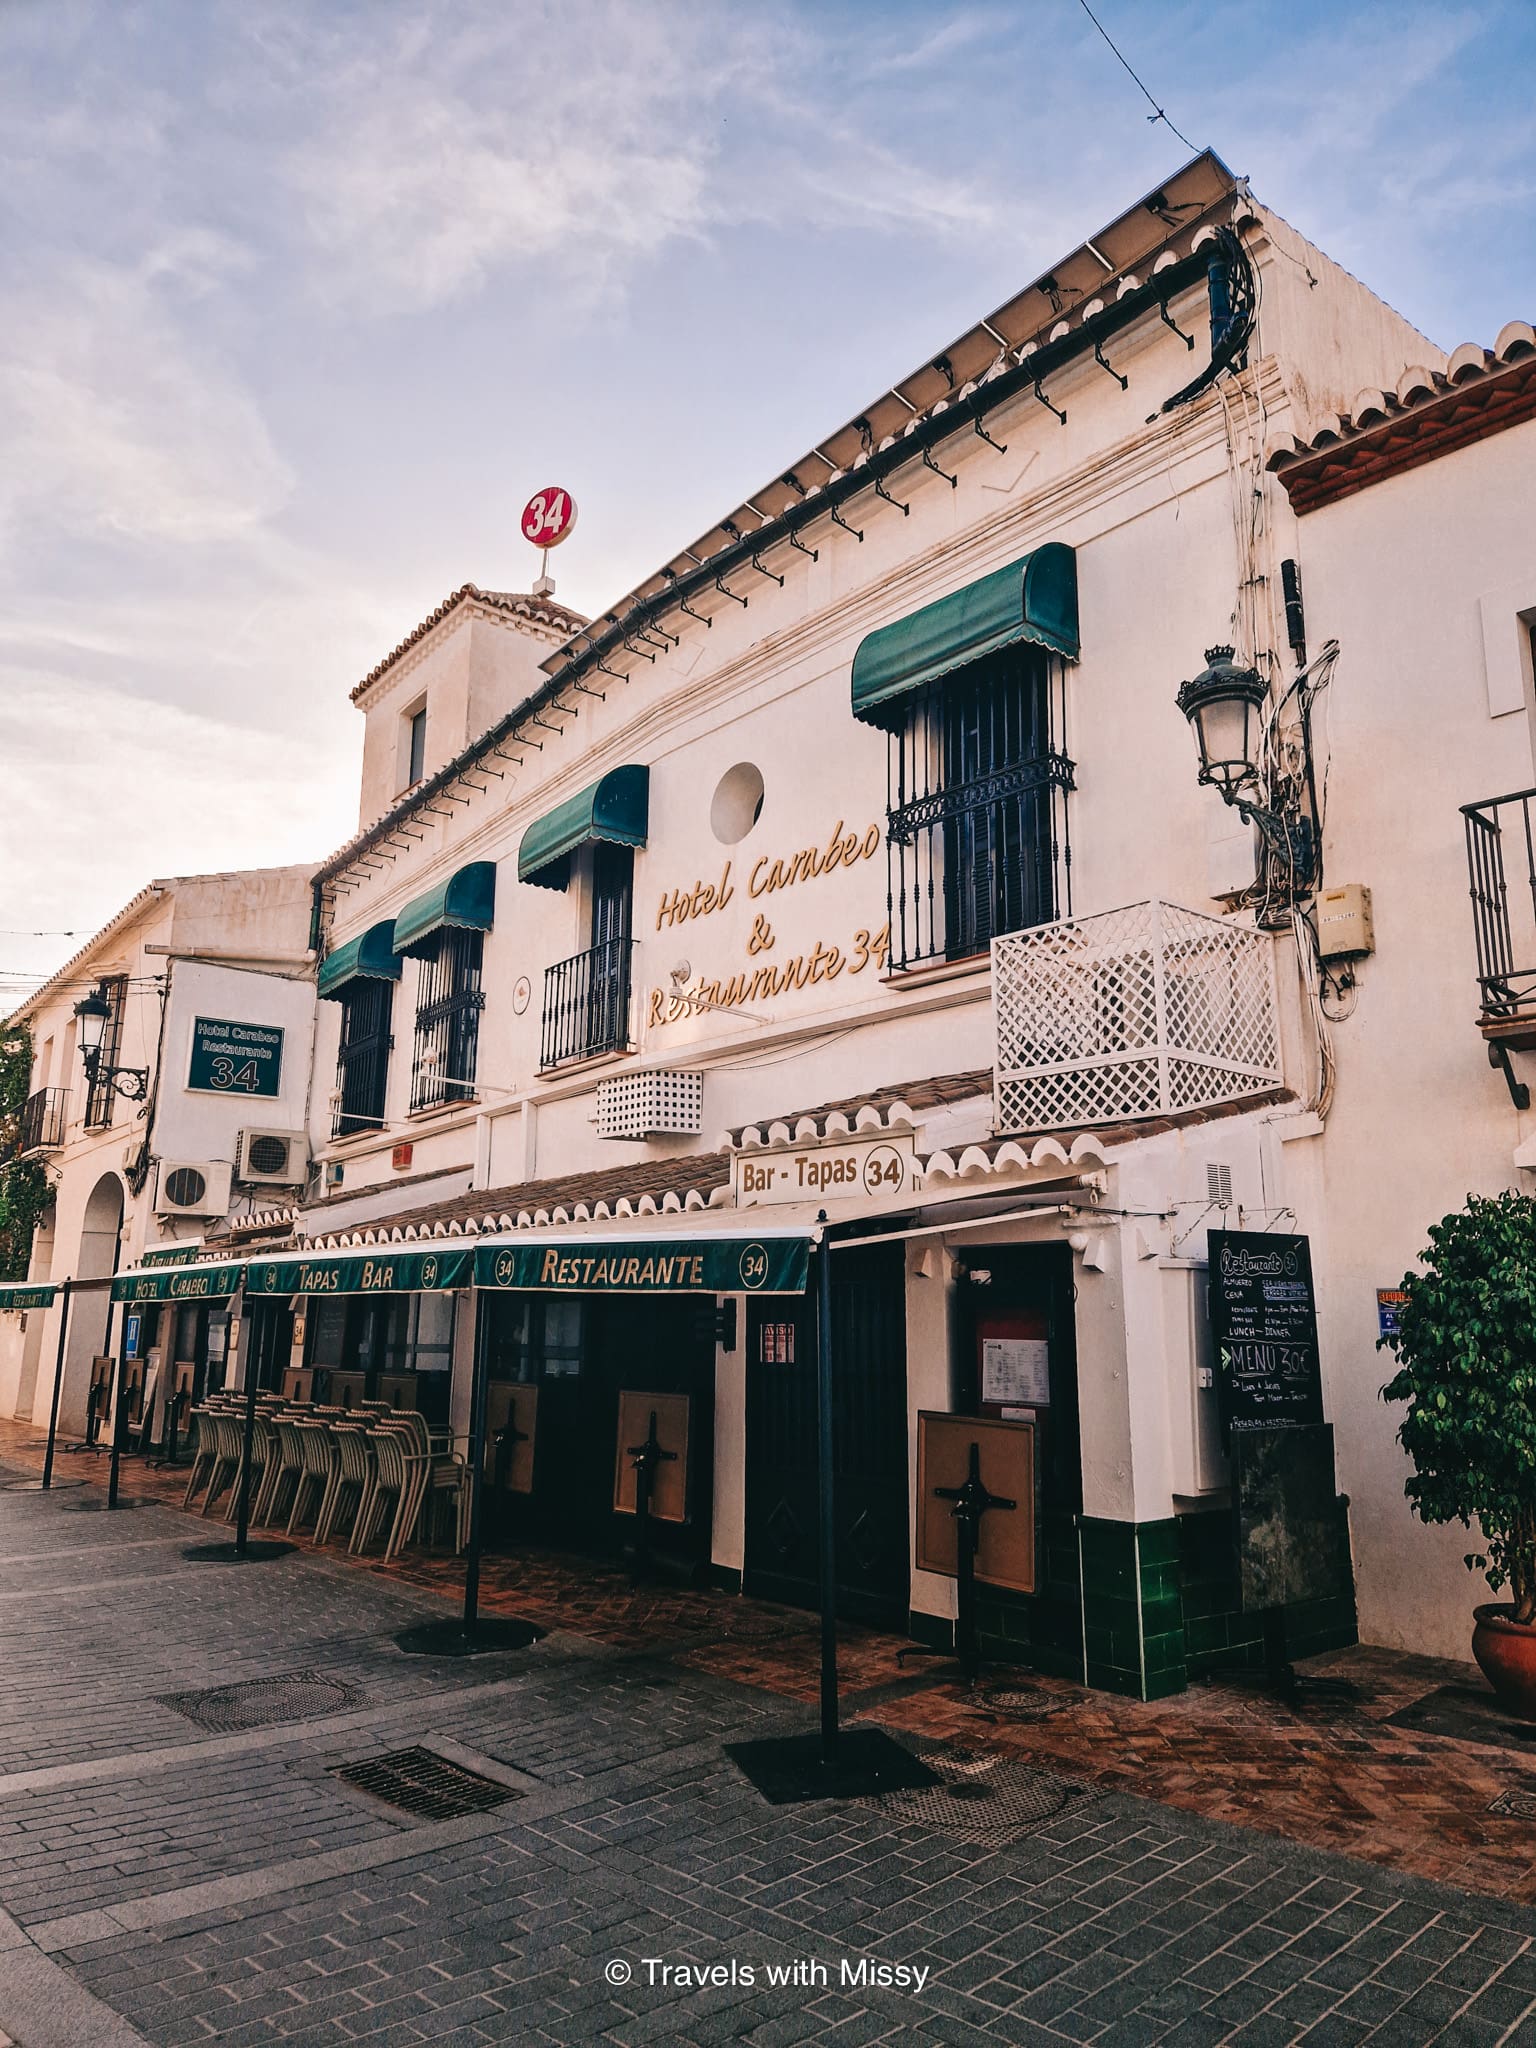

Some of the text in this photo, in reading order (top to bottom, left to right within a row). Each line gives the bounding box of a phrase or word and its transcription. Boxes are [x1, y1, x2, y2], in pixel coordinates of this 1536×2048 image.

[526, 492, 565, 537] 34
[656, 820, 880, 931] Hotel Carabeo
[746, 914, 775, 956] &
[648, 921, 891, 1028] Restaurante 34
[198, 1023, 280, 1043] Hotel Carabeo
[202, 1040, 272, 1059] Restaurante
[210, 1057, 260, 1091] 34
[743, 1164, 775, 1192] Bar
[795, 1156, 857, 1192] Tapas
[868, 1158, 900, 1186] 34
[267, 1261, 435, 1290] 34 TAPAS BAR 34
[499, 1249, 763, 1285] 34 RESTAURANTE 34
[1229, 1327, 1255, 1336] LUNCH
